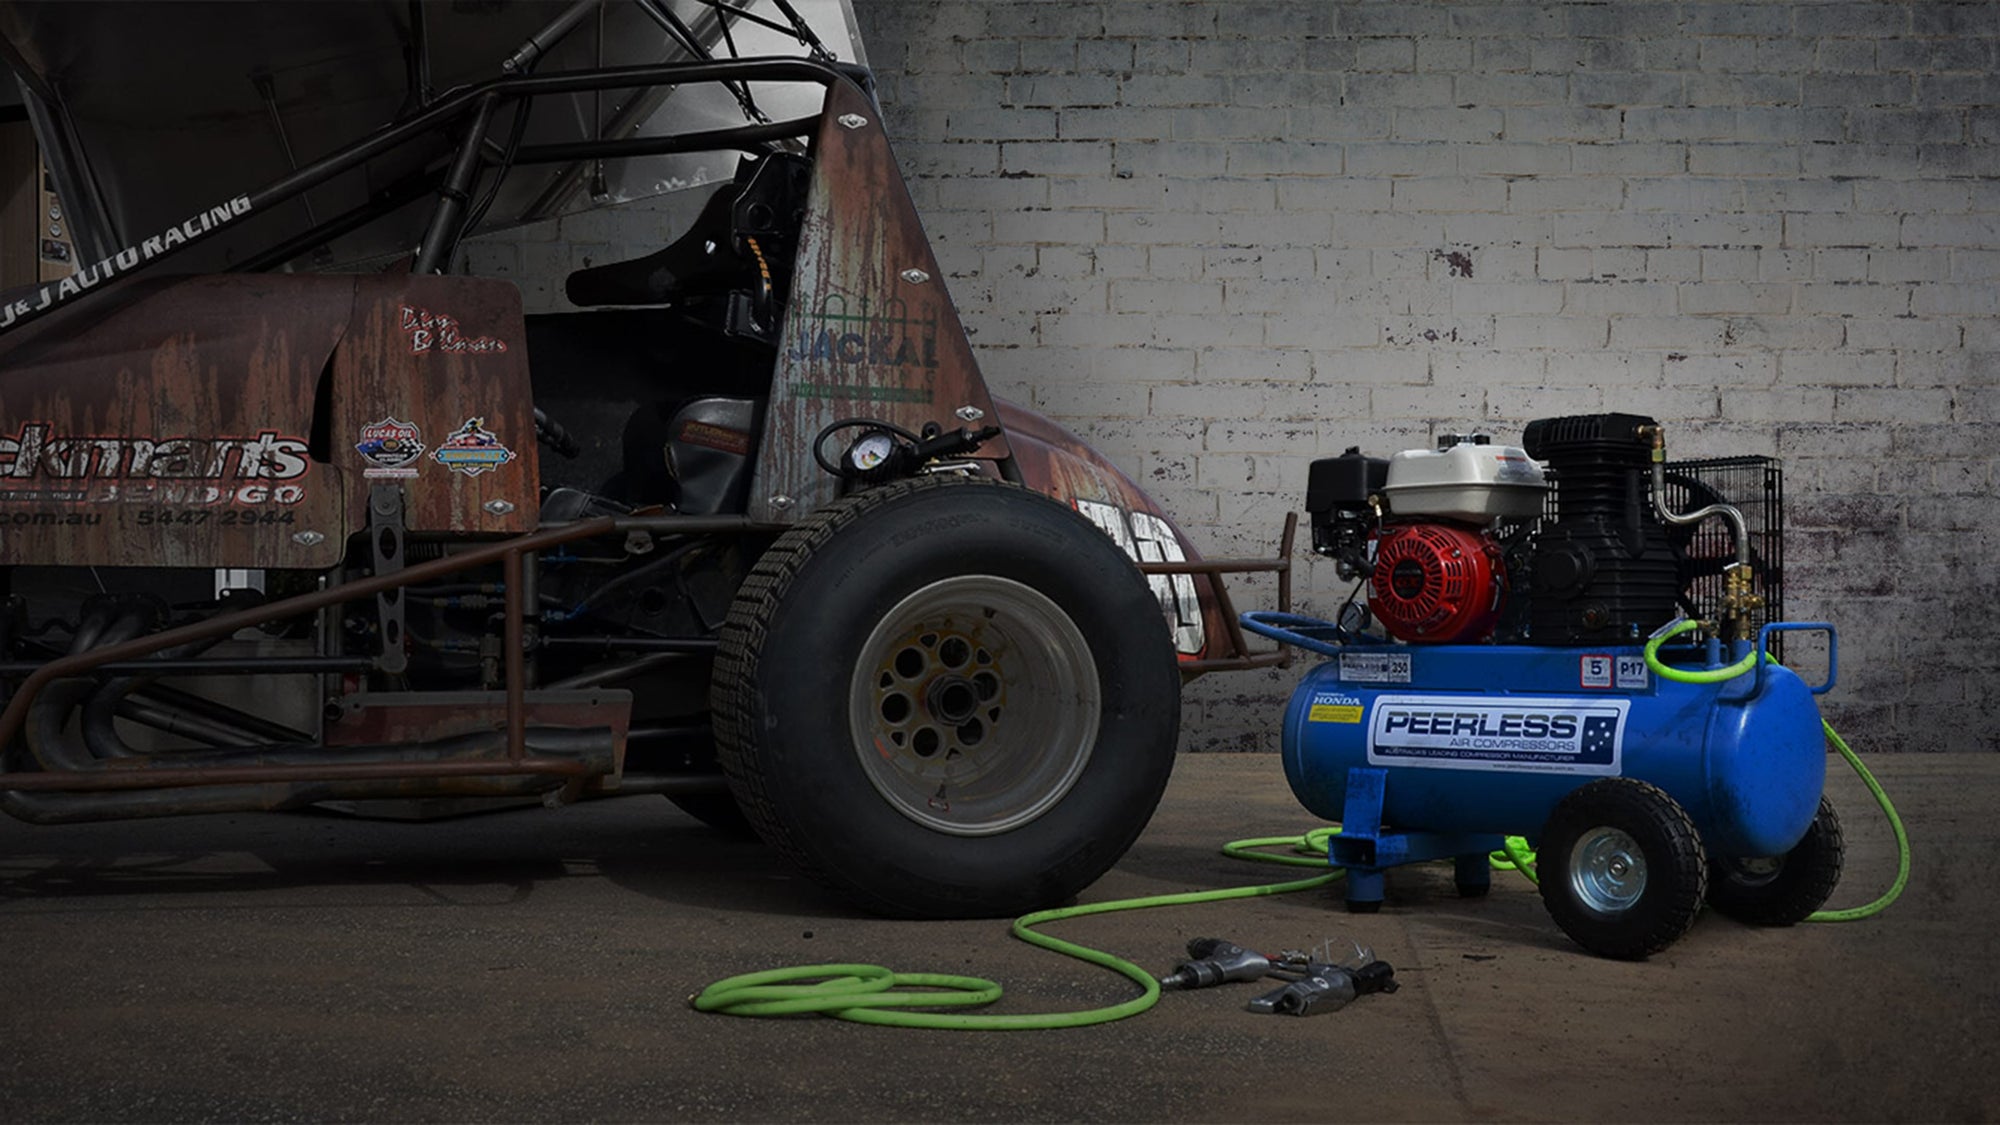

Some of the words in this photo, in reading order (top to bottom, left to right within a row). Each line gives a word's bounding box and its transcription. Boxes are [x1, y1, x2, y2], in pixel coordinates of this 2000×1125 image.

[59, 246, 139, 300] AUTO
[142, 193, 252, 260] RACING
[367, 429, 397, 438] LUCAS
[398, 429, 412, 438] OIL
[137, 510, 212, 526] 5447
[221, 510, 295, 526] 2944
[1591, 660, 1602, 675] 5
[1620, 662, 1643, 675] P17
[1313, 696, 1360, 705] HONDA
[1385, 711, 1577, 738] PEERLESS
[1449, 738, 1470, 747] AIR
[1473, 738, 1576, 751] COMPRESSORS
[1429, 749, 1458, 757] LEADING
[1460, 750, 1511, 760] COMPRESSOR
[1512, 752, 1575, 762] MANUFACTURER
